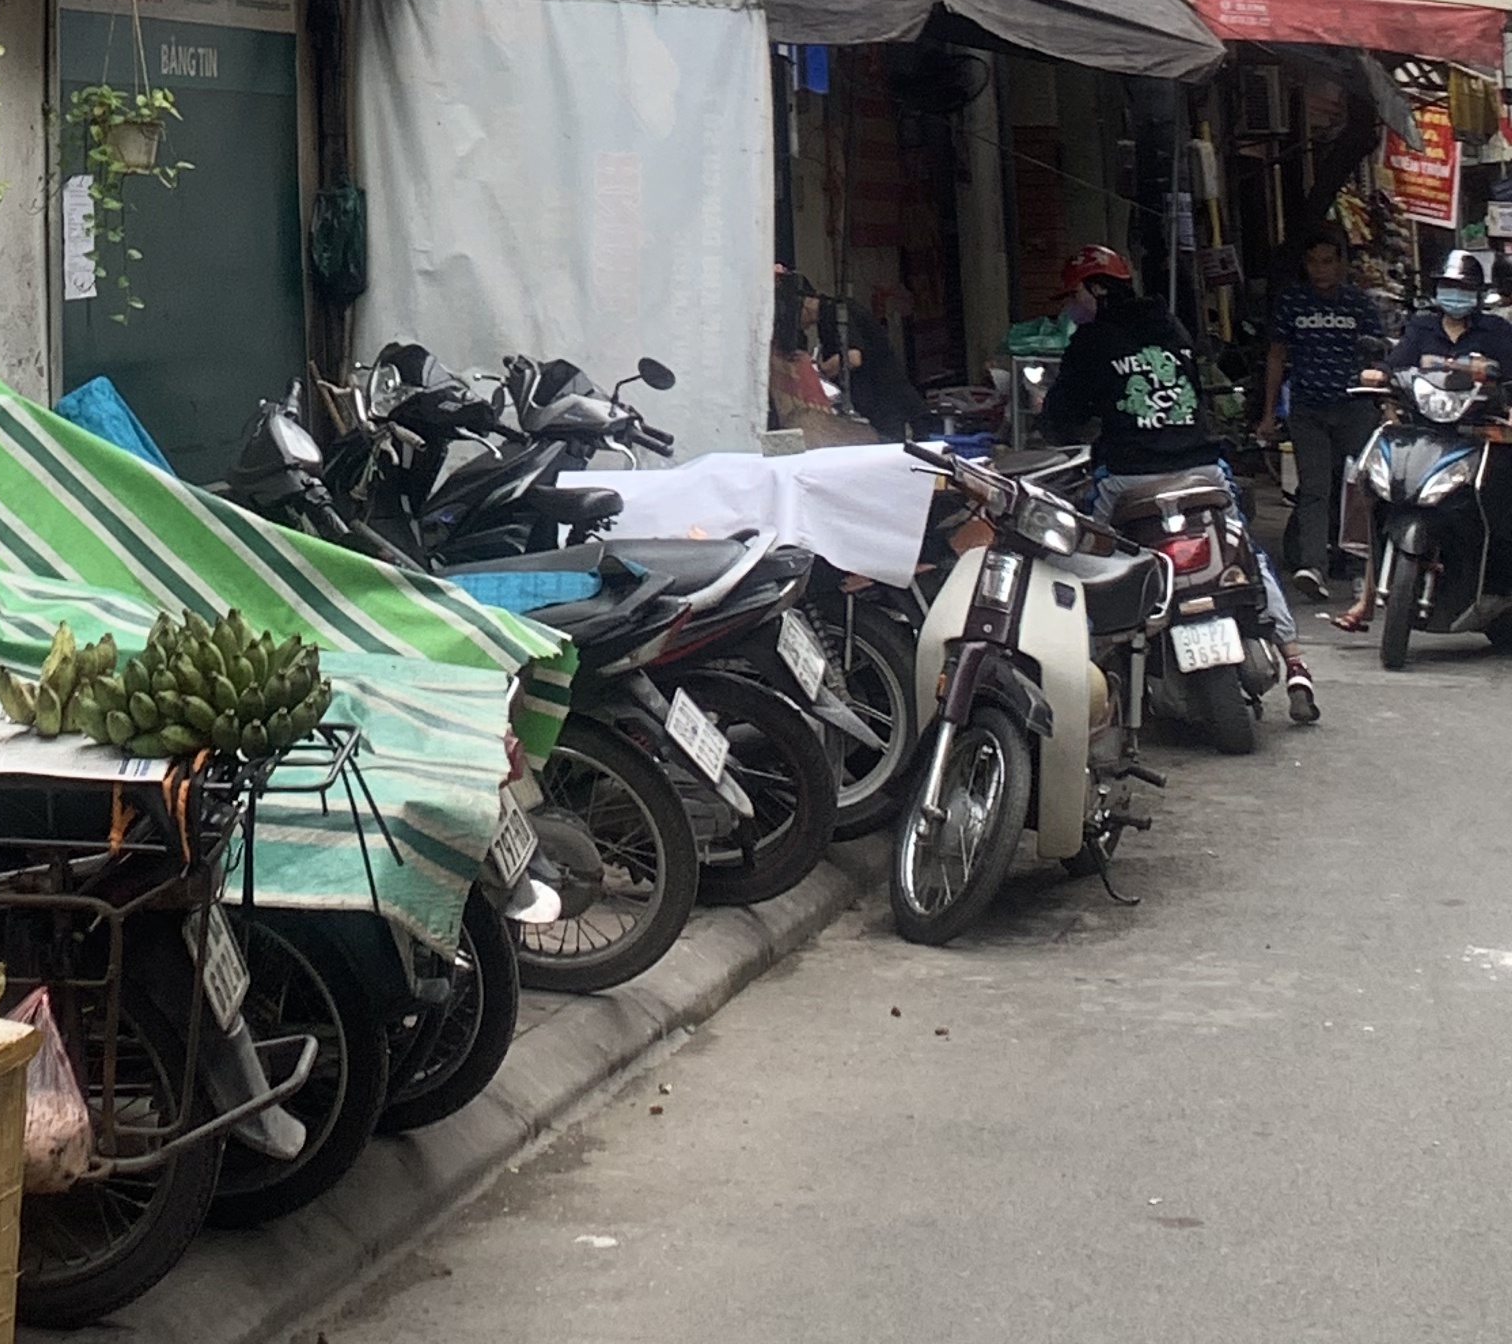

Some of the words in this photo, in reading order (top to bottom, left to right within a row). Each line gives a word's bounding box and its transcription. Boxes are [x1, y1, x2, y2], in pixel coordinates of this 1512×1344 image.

[161, 34, 196, 78] BẢNG
[197, 47, 219, 78] TIN
[1295, 315, 1356, 330] adidas
